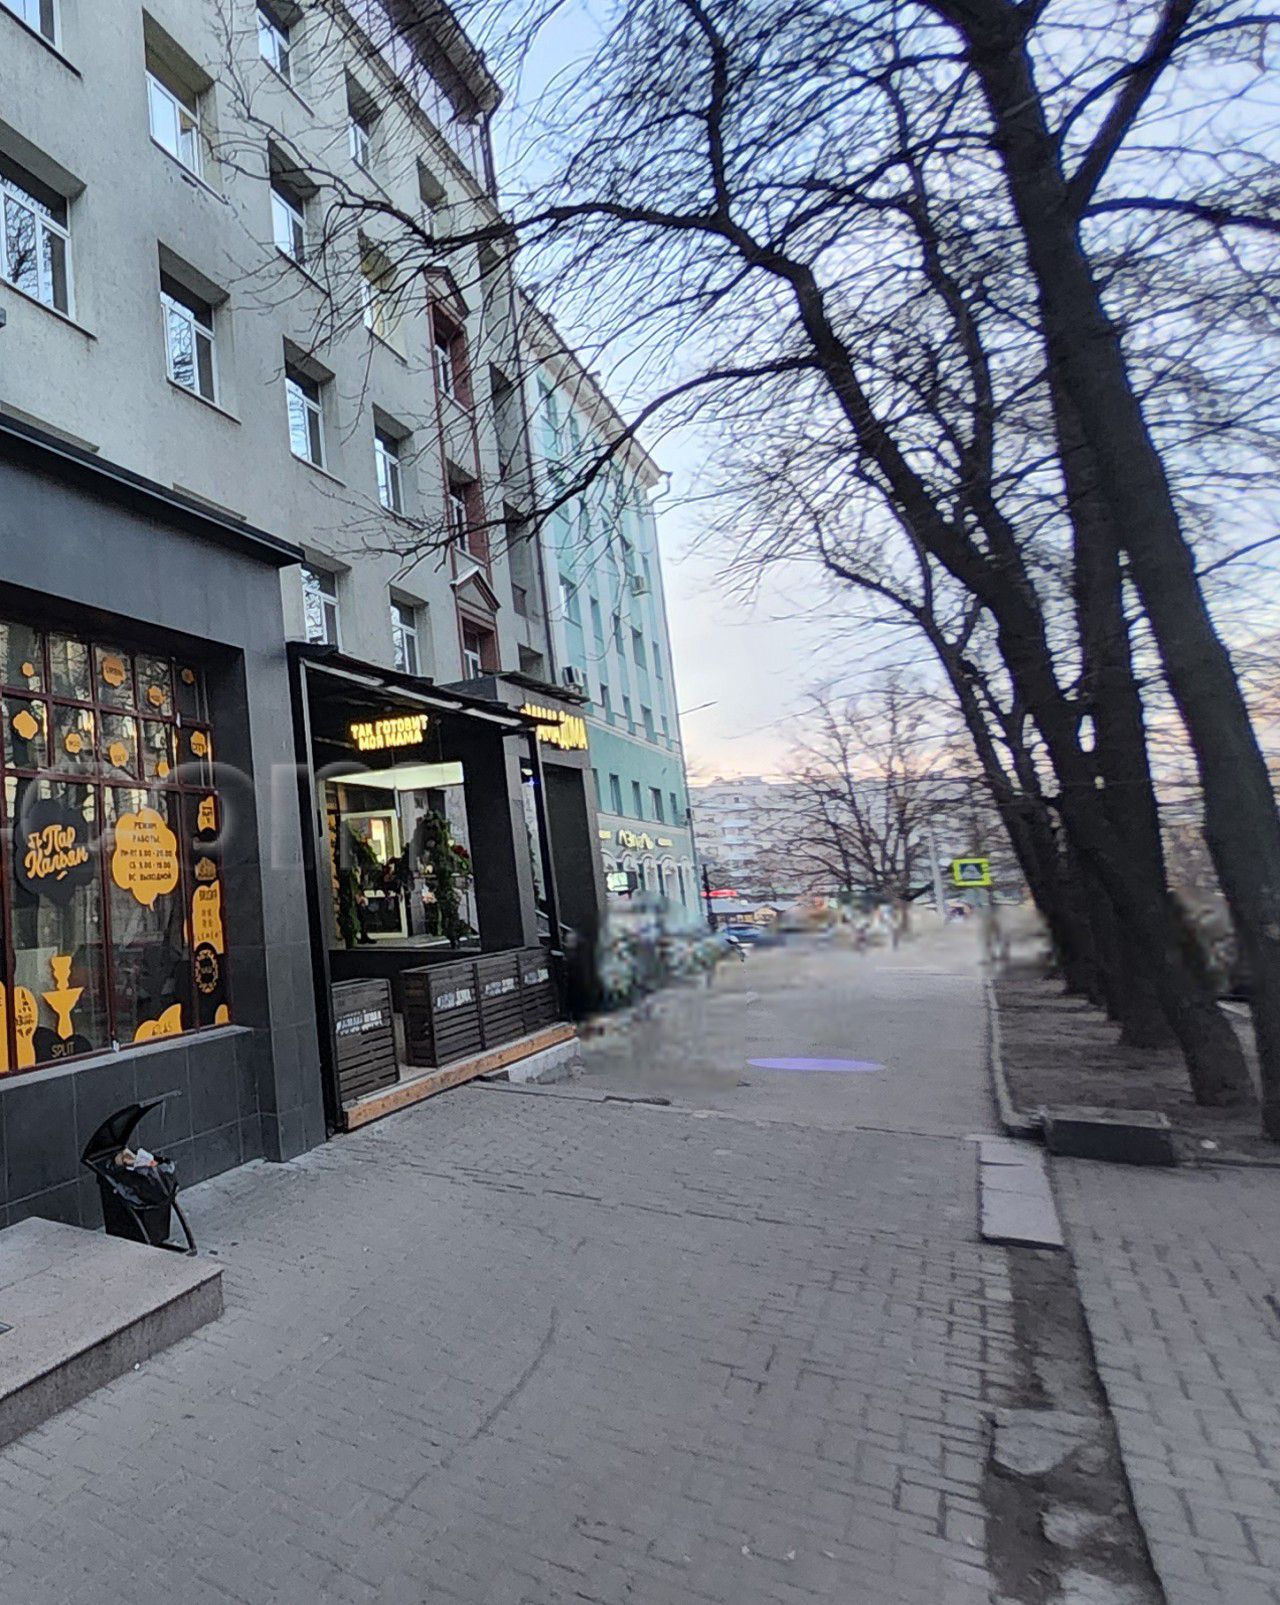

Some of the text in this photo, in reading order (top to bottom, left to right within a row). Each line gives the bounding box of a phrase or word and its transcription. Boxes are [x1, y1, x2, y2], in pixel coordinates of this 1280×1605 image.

[350, 714, 429, 740] ТАК ГОТОВИТ
[358, 730, 423, 751] МОЯ МАМА
